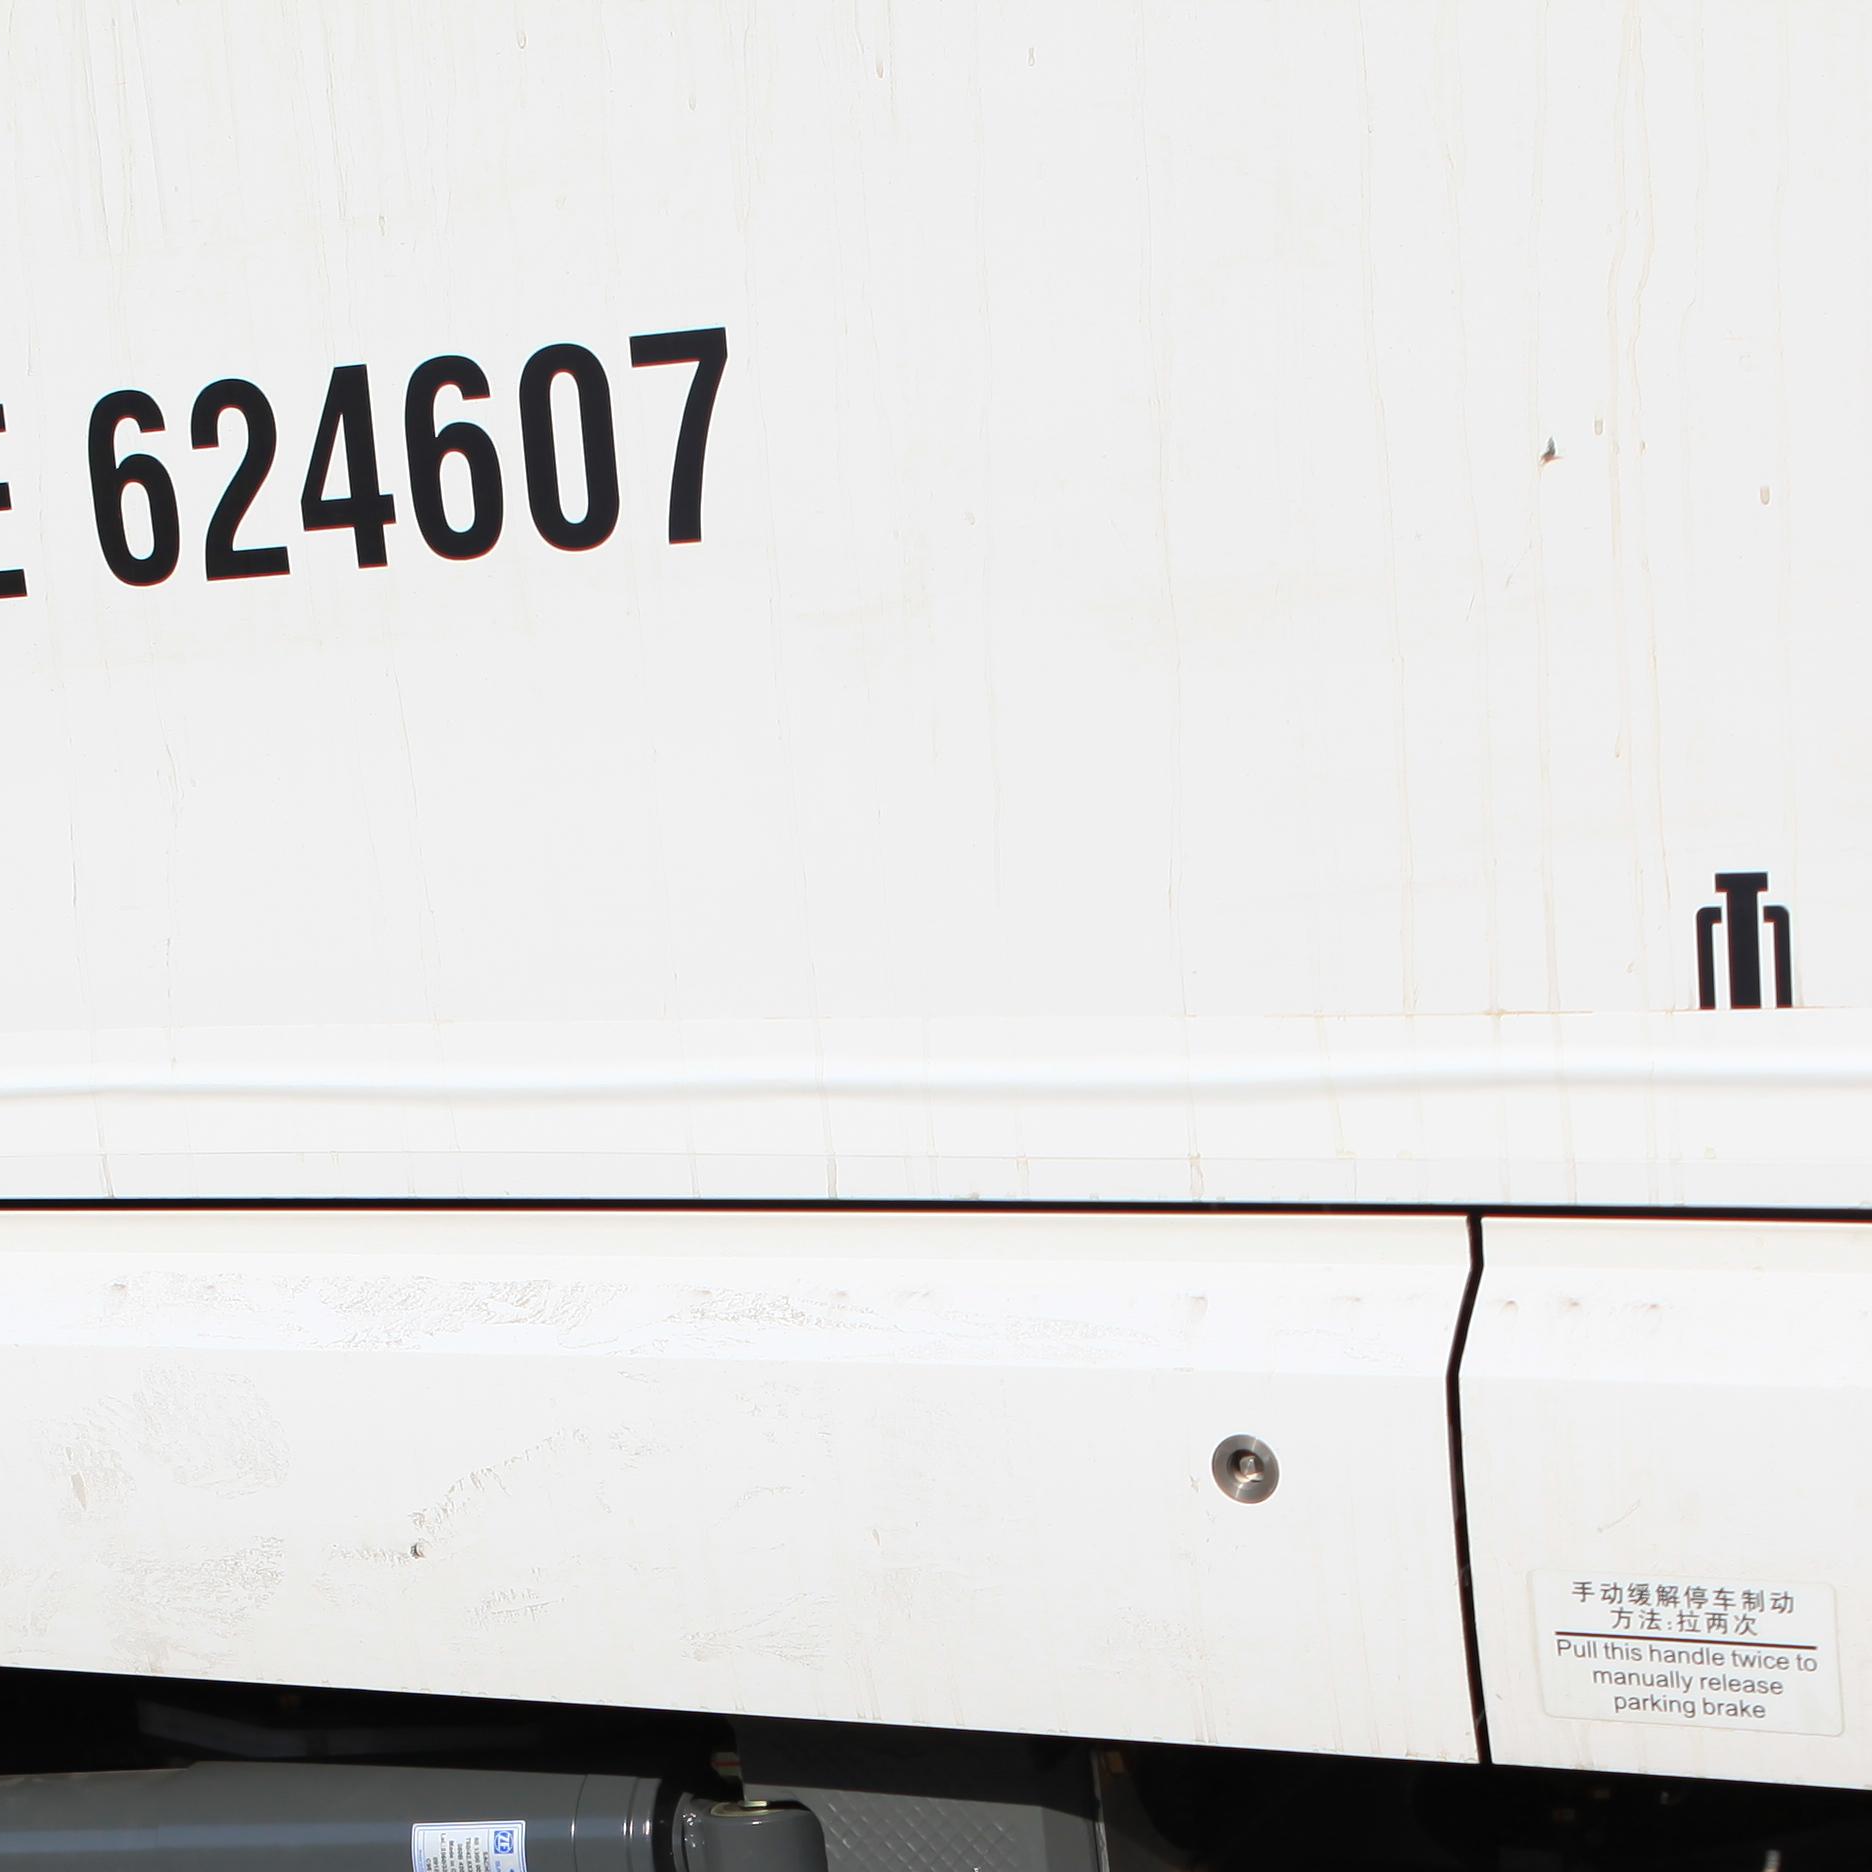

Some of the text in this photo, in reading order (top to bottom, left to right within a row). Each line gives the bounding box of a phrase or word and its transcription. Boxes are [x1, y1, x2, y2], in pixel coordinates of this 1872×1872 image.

[87, 327, 728, 587] 624607
[1571, 1580, 1796, 1615] 手动缓解停车制动
[1556, 1638, 1818, 1673] Pull this handle twice to
[1592, 1667, 1784, 1695] manually release
[1614, 1692, 1767, 1719] parking brake
